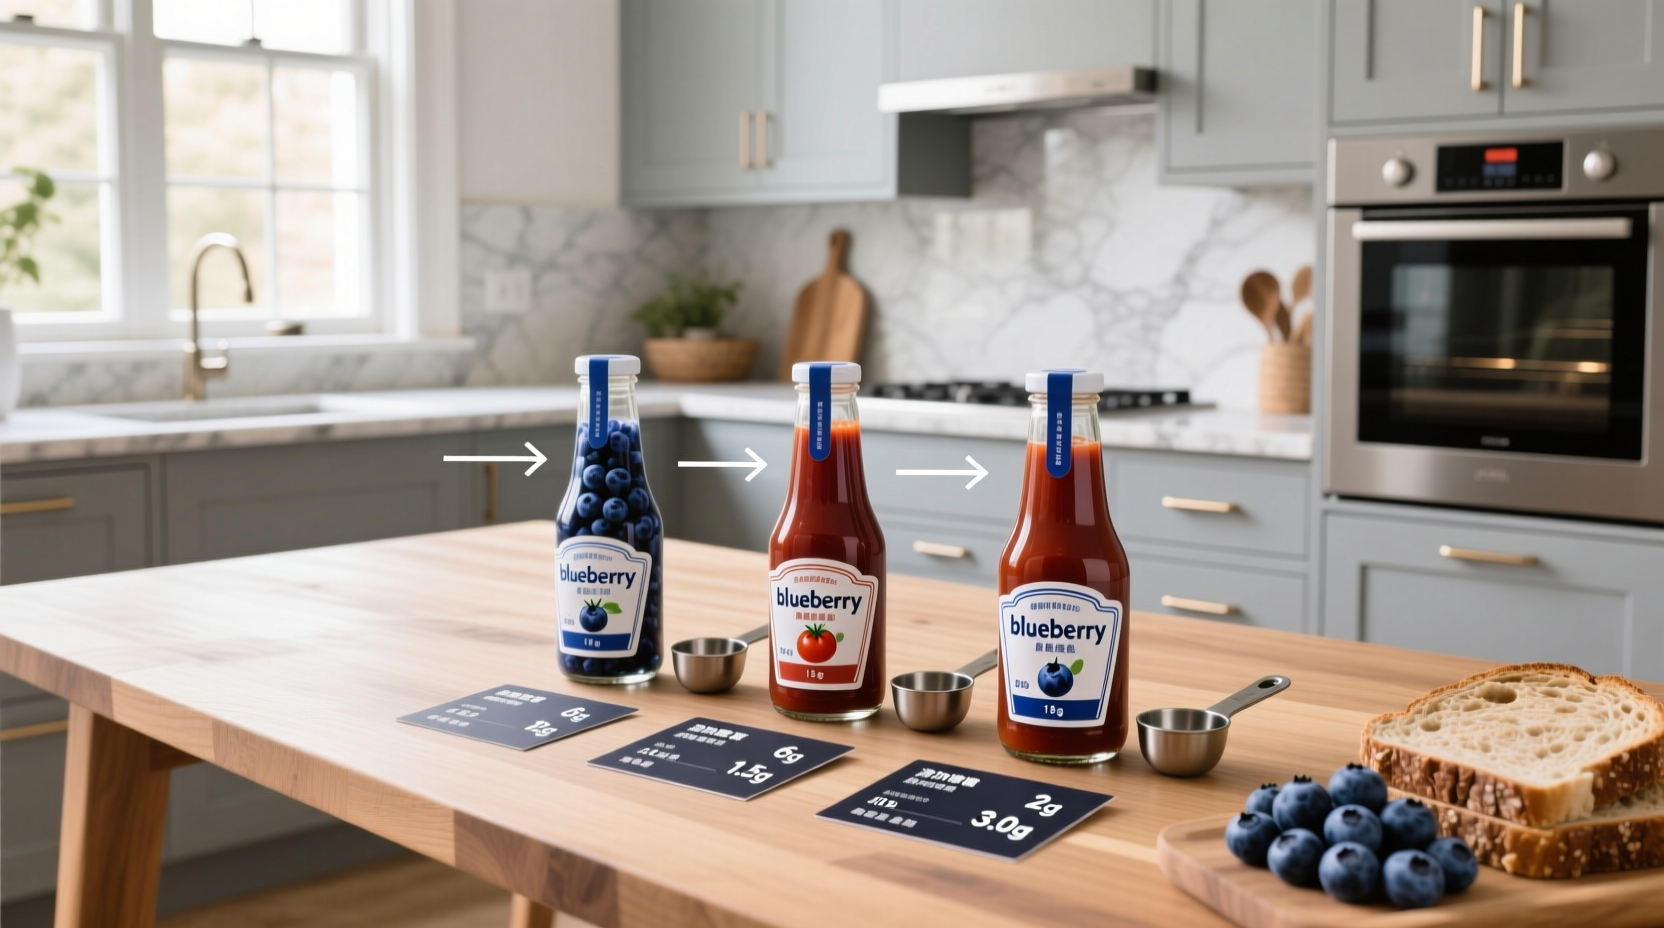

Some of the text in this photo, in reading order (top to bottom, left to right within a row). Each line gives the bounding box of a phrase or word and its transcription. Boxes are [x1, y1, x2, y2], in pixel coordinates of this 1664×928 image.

[559, 563, 637, 589] blueberry
[776, 586, 863, 615] blueberry
[1010, 613, 1107, 646] blueberry
[773, 745, 804, 765] 6g
[726, 760, 774, 784] 1.5g
[1024, 793, 1063, 817] 2g
[970, 810, 1034, 841] 3.0g
